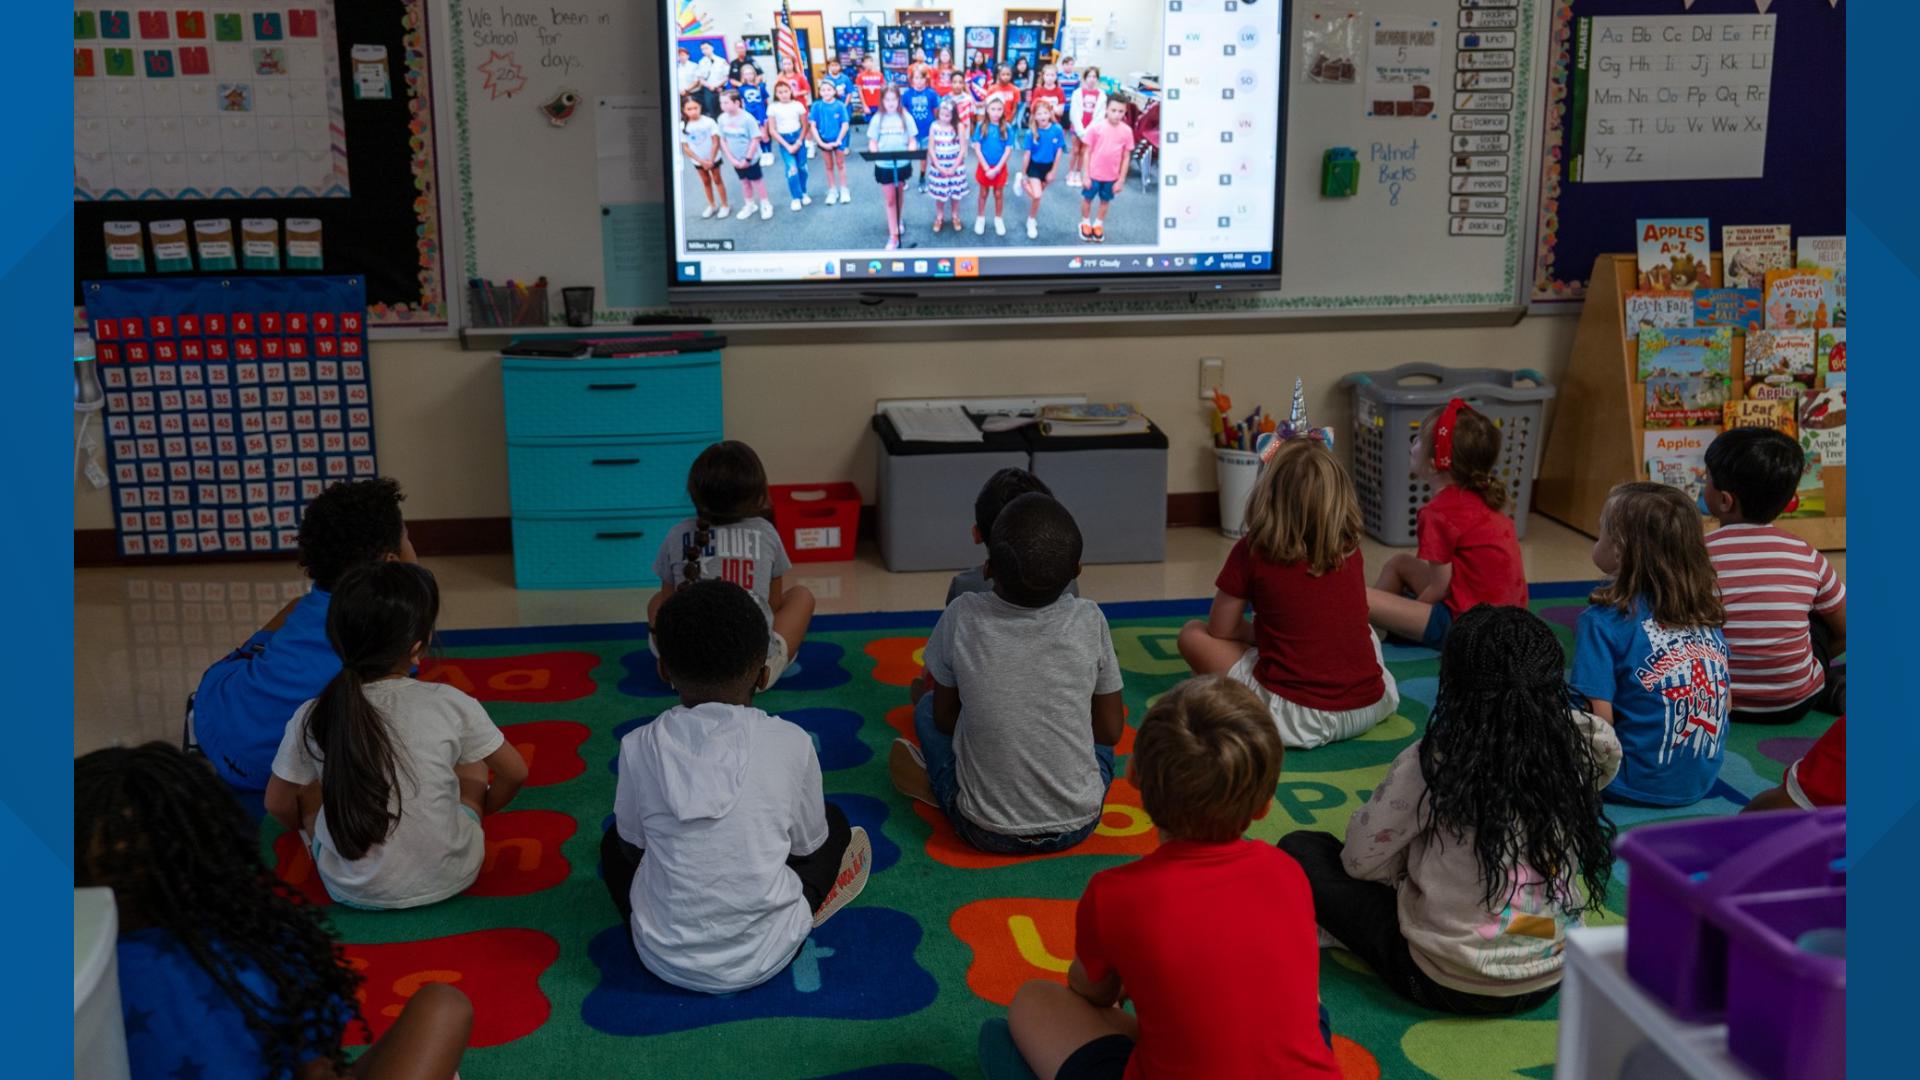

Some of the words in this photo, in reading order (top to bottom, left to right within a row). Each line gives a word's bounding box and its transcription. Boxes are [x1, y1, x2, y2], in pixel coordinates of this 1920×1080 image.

[111, 15, 123, 33] 2
[185, 18, 196, 33] 4
[261, 17, 275, 35] 6
[468, 7, 491, 28] We
[500, 6, 538, 27] have
[551, 7, 588, 25] been
[598, 10, 610, 24] in
[473, 31, 518, 48] School
[536, 27, 562, 47] for
[1600, 27, 1623, 43] Aa
[1632, 26, 1651, 43] Bb
[1662, 26, 1682, 42] Cc
[1692, 25, 1712, 42] Dd
[1722, 25, 1741, 42] Ee
[1752, 24, 1770, 41] Ff
[112, 53, 124, 70] 9
[150, 55, 169, 72] 10
[1397, 47, 1407, 64] 5
[496, 67, 516, 81] 20
[1598, 56, 1621, 78] Gg
[1629, 56, 1650, 72] Hh
[1666, 55, 1675, 71] Ii
[1691, 54, 1710, 78] Jj
[1720, 54, 1738, 70] Kk
[1751, 53, 1766, 70] Ll
[1594, 88, 1622, 104] Mm
[1628, 88, 1648, 104] Nn
[1657, 87, 1678, 104] Oo
[1687, 86, 1706, 108] Pp
[1715, 85, 1739, 108] Qq
[1746, 85, 1765, 102] Rr
[1597, 119, 1614, 135] Ss
[1628, 118, 1644, 134] Tt
[1655, 118, 1675, 134] Uu
[1687, 117, 1703, 133] Vv
[1712, 117, 1738, 133] Ww
[1744, 116, 1762, 132] Xx
[1370, 139, 1421, 163] Patriot
[1595, 147, 1613, 169] Yy
[1625, 147, 1644, 163] Zz
[1477, 159, 1500, 168] math
[1378, 165, 1417, 186] Bucks
[1473, 180, 1502, 189] recess
[1388, 182, 1401, 207] 8
[1475, 200, 1500, 208] snack
[1468, 222, 1489, 232] pack
[1492, 223, 1504, 232] up
[1643, 224, 1705, 243] APPLES
[1661, 242, 1671, 254] A
[1679, 242, 1686, 253] Z
[1099, 259, 1121, 269] Cloudy
[1790, 286, 1824, 299] Party!
[1631, 299, 1649, 313] Let
[1653, 300, 1664, 313] It
[1666, 300, 1688, 314] Fall
[105, 324, 110, 335] 1
[128, 323, 135, 334] 2
[158, 321, 165, 333] 3
[184, 320, 192, 330] 4
[211, 320, 218, 330] 5
[238, 319, 246, 329] 6
[267, 318, 273, 328] 7
[292, 318, 299, 329] 8
[320, 318, 327, 328] 9
[344, 318, 356, 329] 10
[104, 349, 112, 359] 11
[131, 348, 142, 358] 12
[160, 347, 171, 357] 13
[186, 346, 198, 355] 14
[211, 344, 222, 355] 15
[240, 344, 251, 354] 16
[267, 343, 277, 353] 17
[290, 343, 301, 353] 18
[320, 342, 332, 352] 19
[343, 342, 357, 352] 20
[1775, 340, 1810, 349] Autumn
[110, 372, 122, 384] 21
[135, 371, 149, 384] 22
[159, 370, 173, 382] 23
[184, 370, 199, 382] 24
[213, 369, 225, 381] 25
[240, 368, 256, 380] 26
[267, 367, 281, 378] 27
[293, 365, 306, 378] 28
[320, 364, 335, 376] 29
[347, 364, 360, 377] 30
[112, 396, 125, 408] 31
[136, 396, 151, 407] 32
[165, 395, 179, 407] 33
[189, 394, 203, 405] 34
[216, 393, 229, 405] 35
[244, 393, 257, 404] 36
[271, 390, 284, 402] 37
[299, 390, 313, 402] 38
[321, 389, 336, 401] 39
[350, 390, 365, 400] 40
[1757, 387, 1800, 400] Apples
[1743, 403, 1776, 416] Leaf
[114, 420, 126, 430] 41
[138, 420, 152, 431] 42
[164, 417, 179, 429] 43
[192, 418, 207, 428] 44
[216, 417, 231, 429] 45
[246, 417, 260, 428] 46
[270, 415, 283, 427] 47
[298, 414, 311, 426] 48
[325, 414, 338, 425] 49
[352, 412, 367, 424] 50
[1731, 416, 1789, 429] Trouble
[1657, 437, 1702, 450] Apples
[1814, 438, 1838, 448] Apple
[1825, 449, 1843, 458] Tree
[1674, 675, 1723, 735] girl
